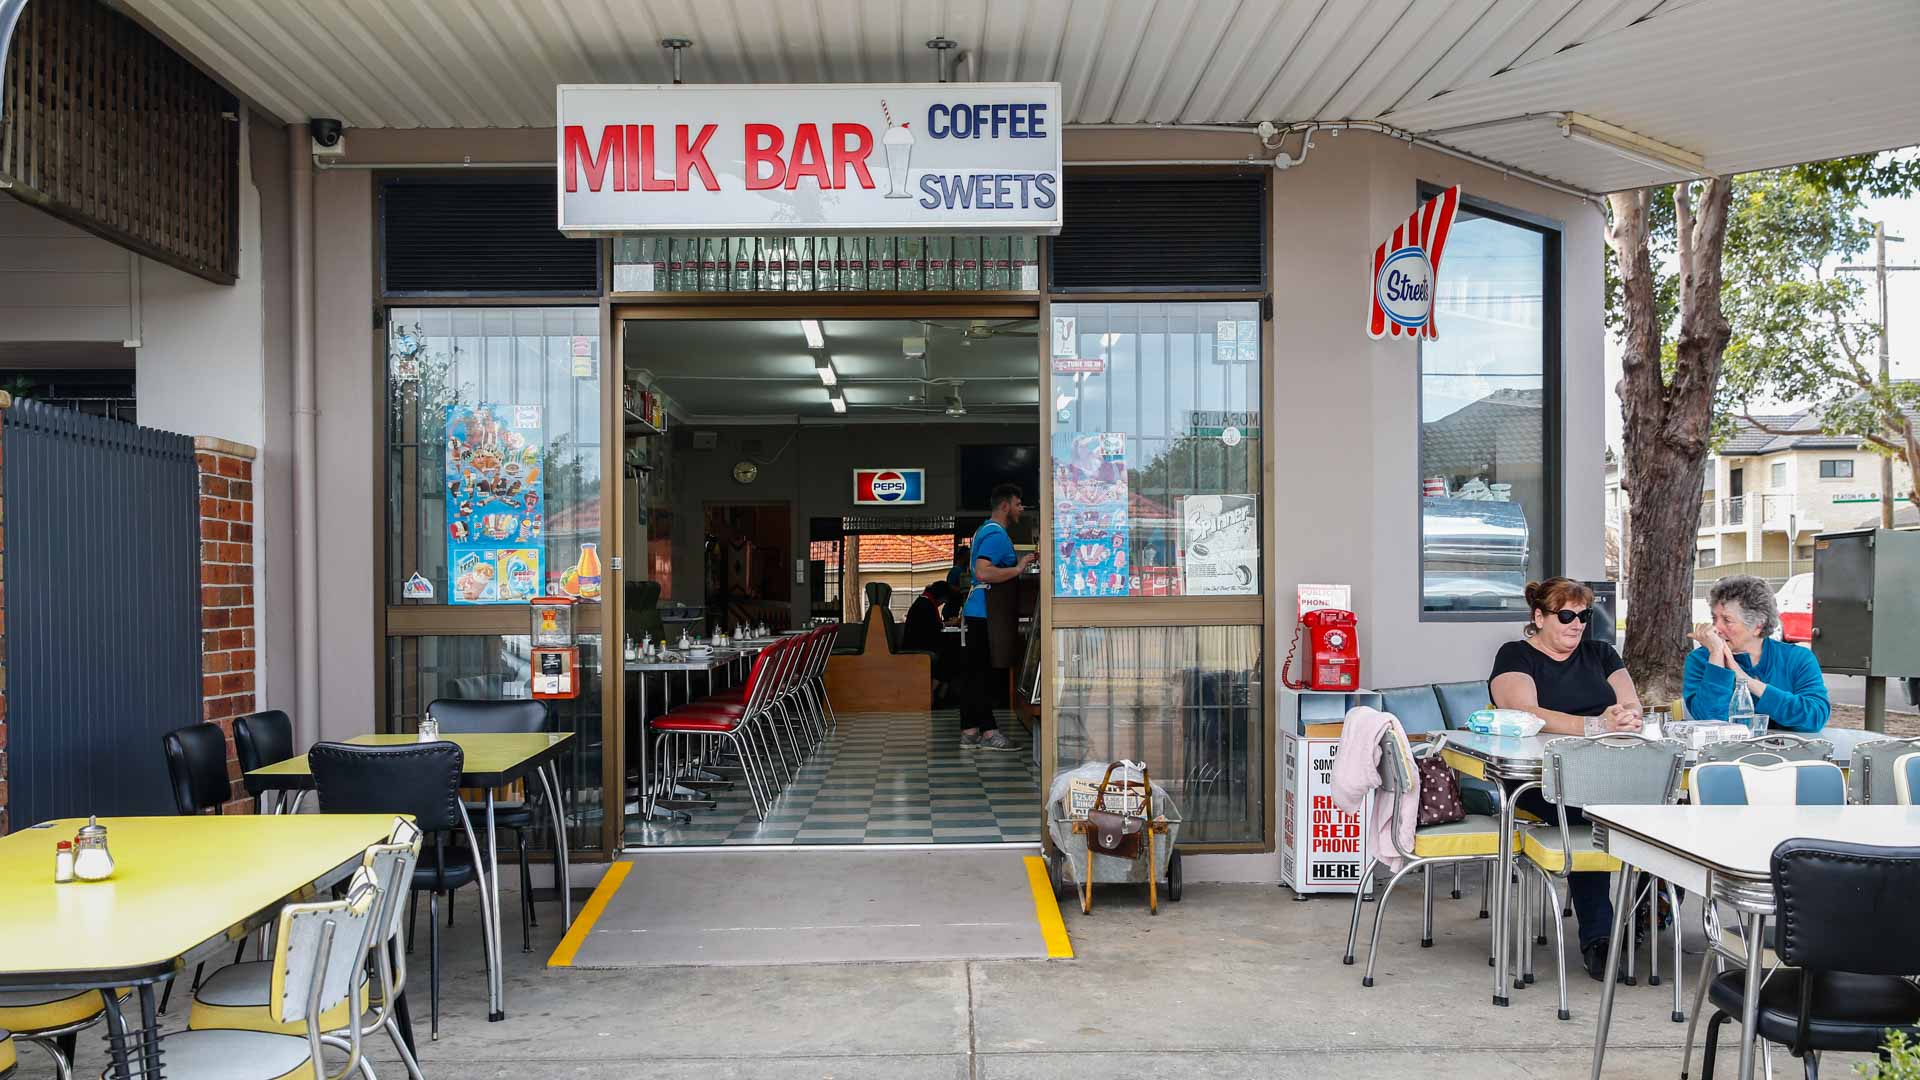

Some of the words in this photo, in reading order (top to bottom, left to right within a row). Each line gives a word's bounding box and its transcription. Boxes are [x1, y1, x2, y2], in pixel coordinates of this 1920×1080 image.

[927, 103, 1047, 139] COFFEE
[565, 124, 721, 193] MILK
[745, 123, 875, 191] BAR
[919, 173, 1056, 210] SWEETS
[1387, 269, 1429, 302] Streets
[873, 482, 905, 491] PEPSI
[1313, 810, 1332, 824] ON
[1337, 810, 1360, 824] THE
[1313, 824, 1360, 838] RED
[1313, 838, 1360, 853] PHONE
[1313, 864, 1360, 878] HERE
